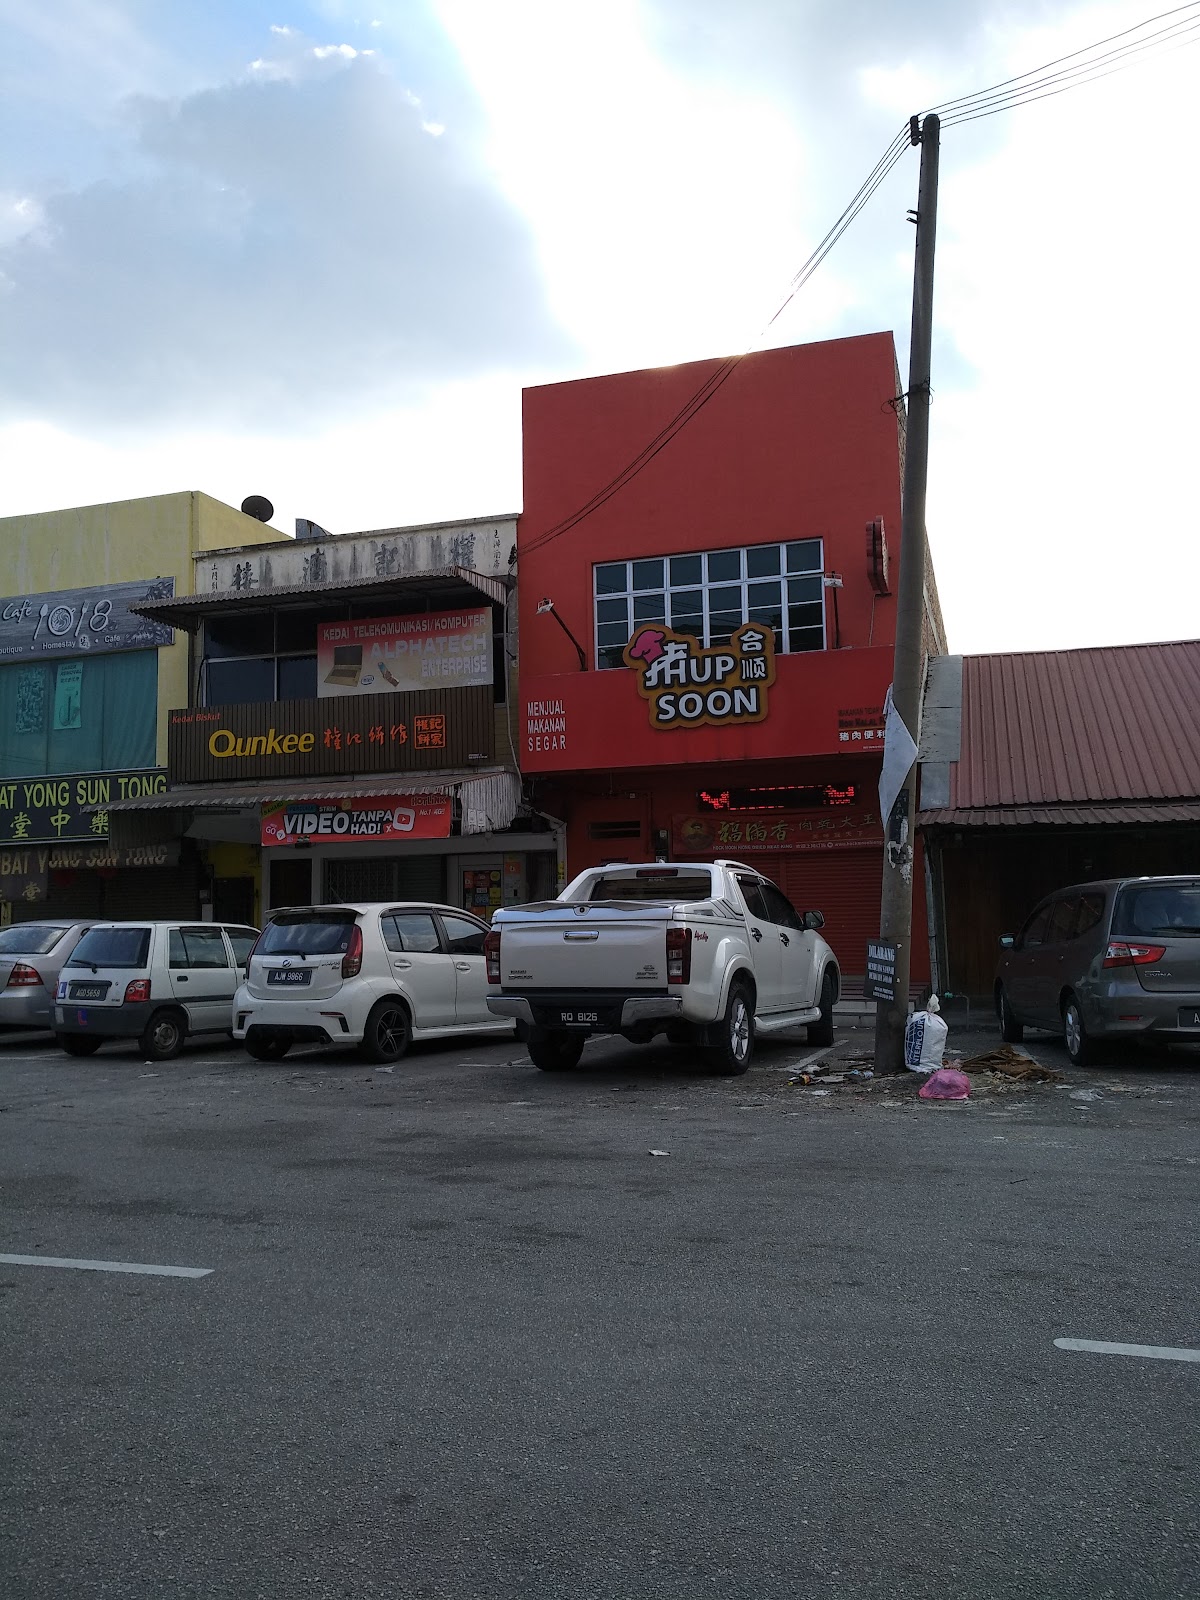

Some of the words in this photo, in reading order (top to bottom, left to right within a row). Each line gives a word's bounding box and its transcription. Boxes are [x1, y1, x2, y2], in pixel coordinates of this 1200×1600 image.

[2, 599, 33, 623] Café
[323, 629, 349, 640] KEDAI
[42, 640, 76, 650] Homestay
[370, 633, 487, 659] ALPHATECH
[740, 630, 766, 679] 合顺
[421, 655, 487, 677] ENTERPRISE
[655, 648, 735, 687] HUP
[527, 700, 565, 716] MENJUAL
[658, 688, 758, 720] SOON
[172, 714, 193, 724] Kedai
[196, 712, 221, 722] Biskut
[527, 717, 565, 734] MAKANAN
[208, 728, 315, 758] Qunkee
[528, 735, 566, 752] SEGAR
[23, 782, 70, 808] YONG
[76, 779, 110, 805] SUN
[118, 775, 167, 800] TONG
[283, 812, 350, 834] VIDEO
[352, 810, 393, 822] TANPA
[350, 823, 381, 834] HAD!
[577, 1012, 598, 1022] 8126
